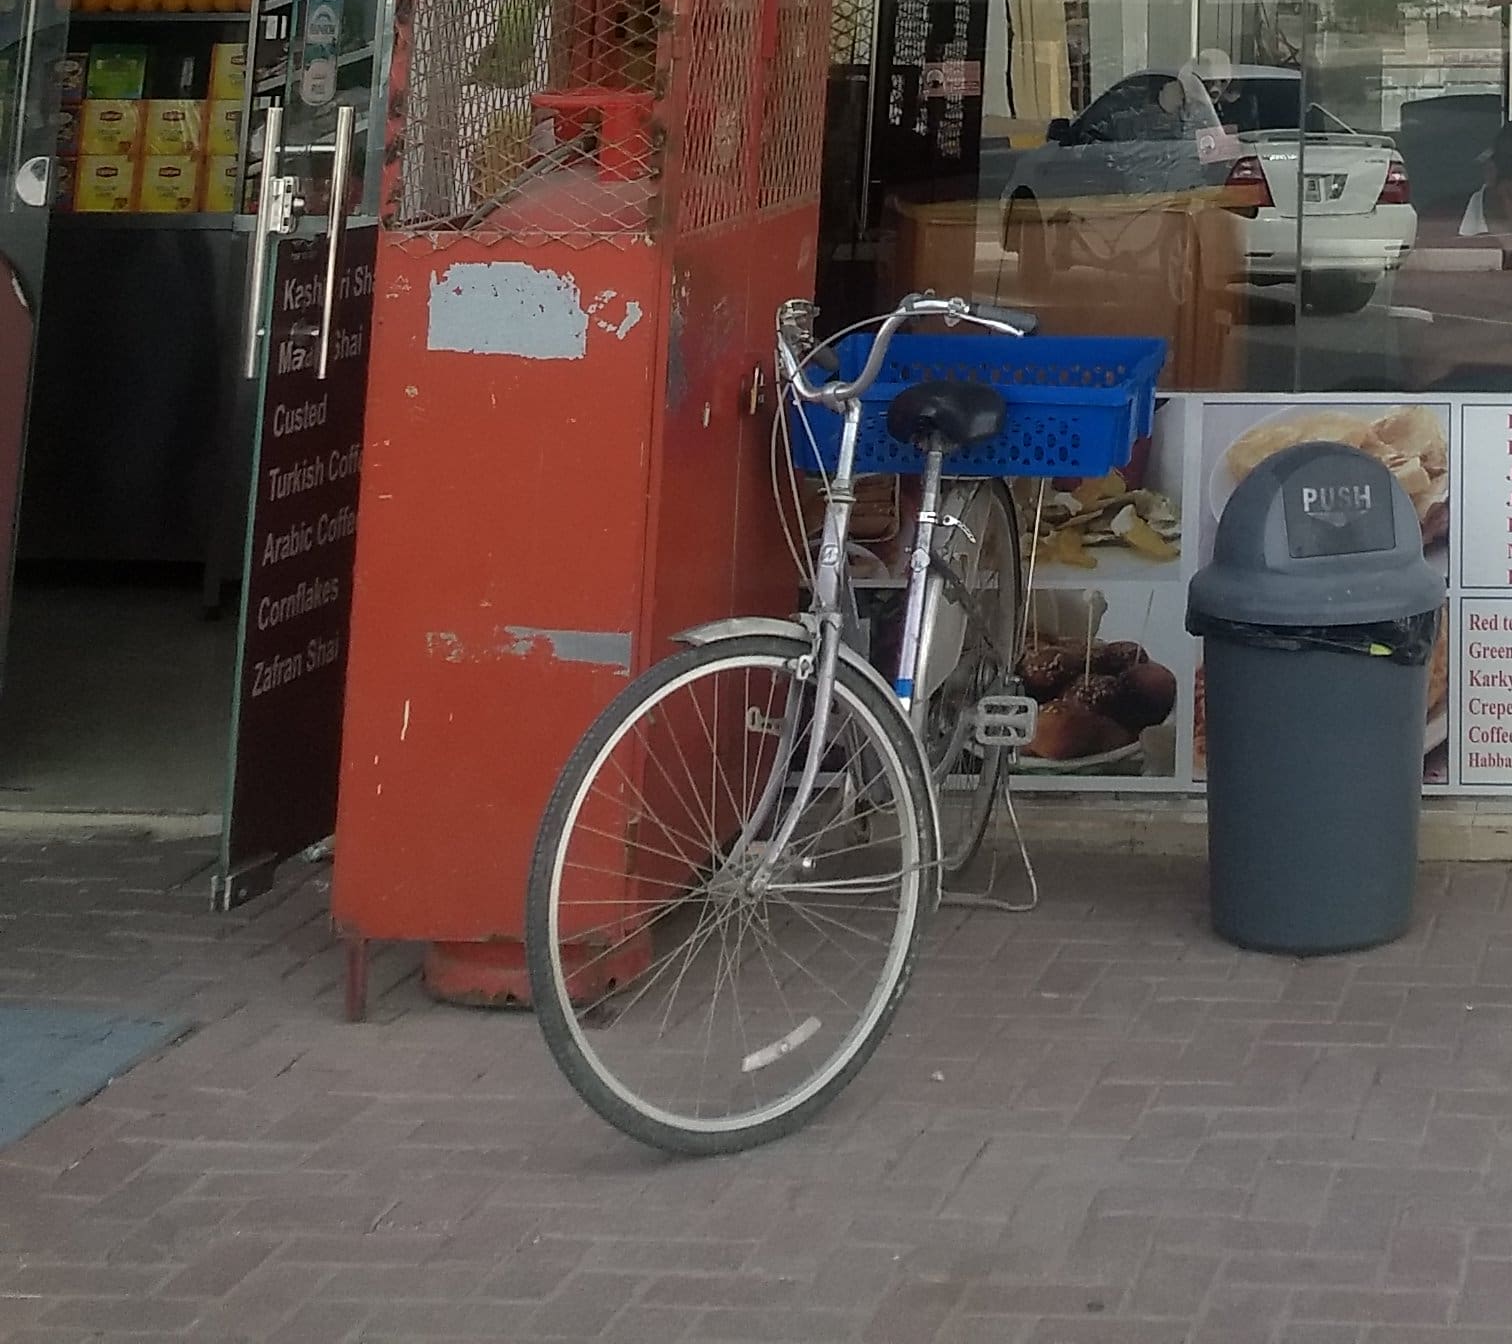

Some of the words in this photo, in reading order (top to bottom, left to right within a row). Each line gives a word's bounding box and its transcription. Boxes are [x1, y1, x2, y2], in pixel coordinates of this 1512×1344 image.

[273, 393, 328, 438] Custed
[269, 455, 324, 501] Turkish
[1302, 484, 1372, 512] PUSH
[262, 522, 313, 567] Arabic
[258, 577, 339, 631] Cornflakes
[1468, 614, 1498, 631] Red
[252, 651, 302, 696] Zafran
[307, 632, 338, 671] Shai
[1468, 752, 1512, 768] Habba
